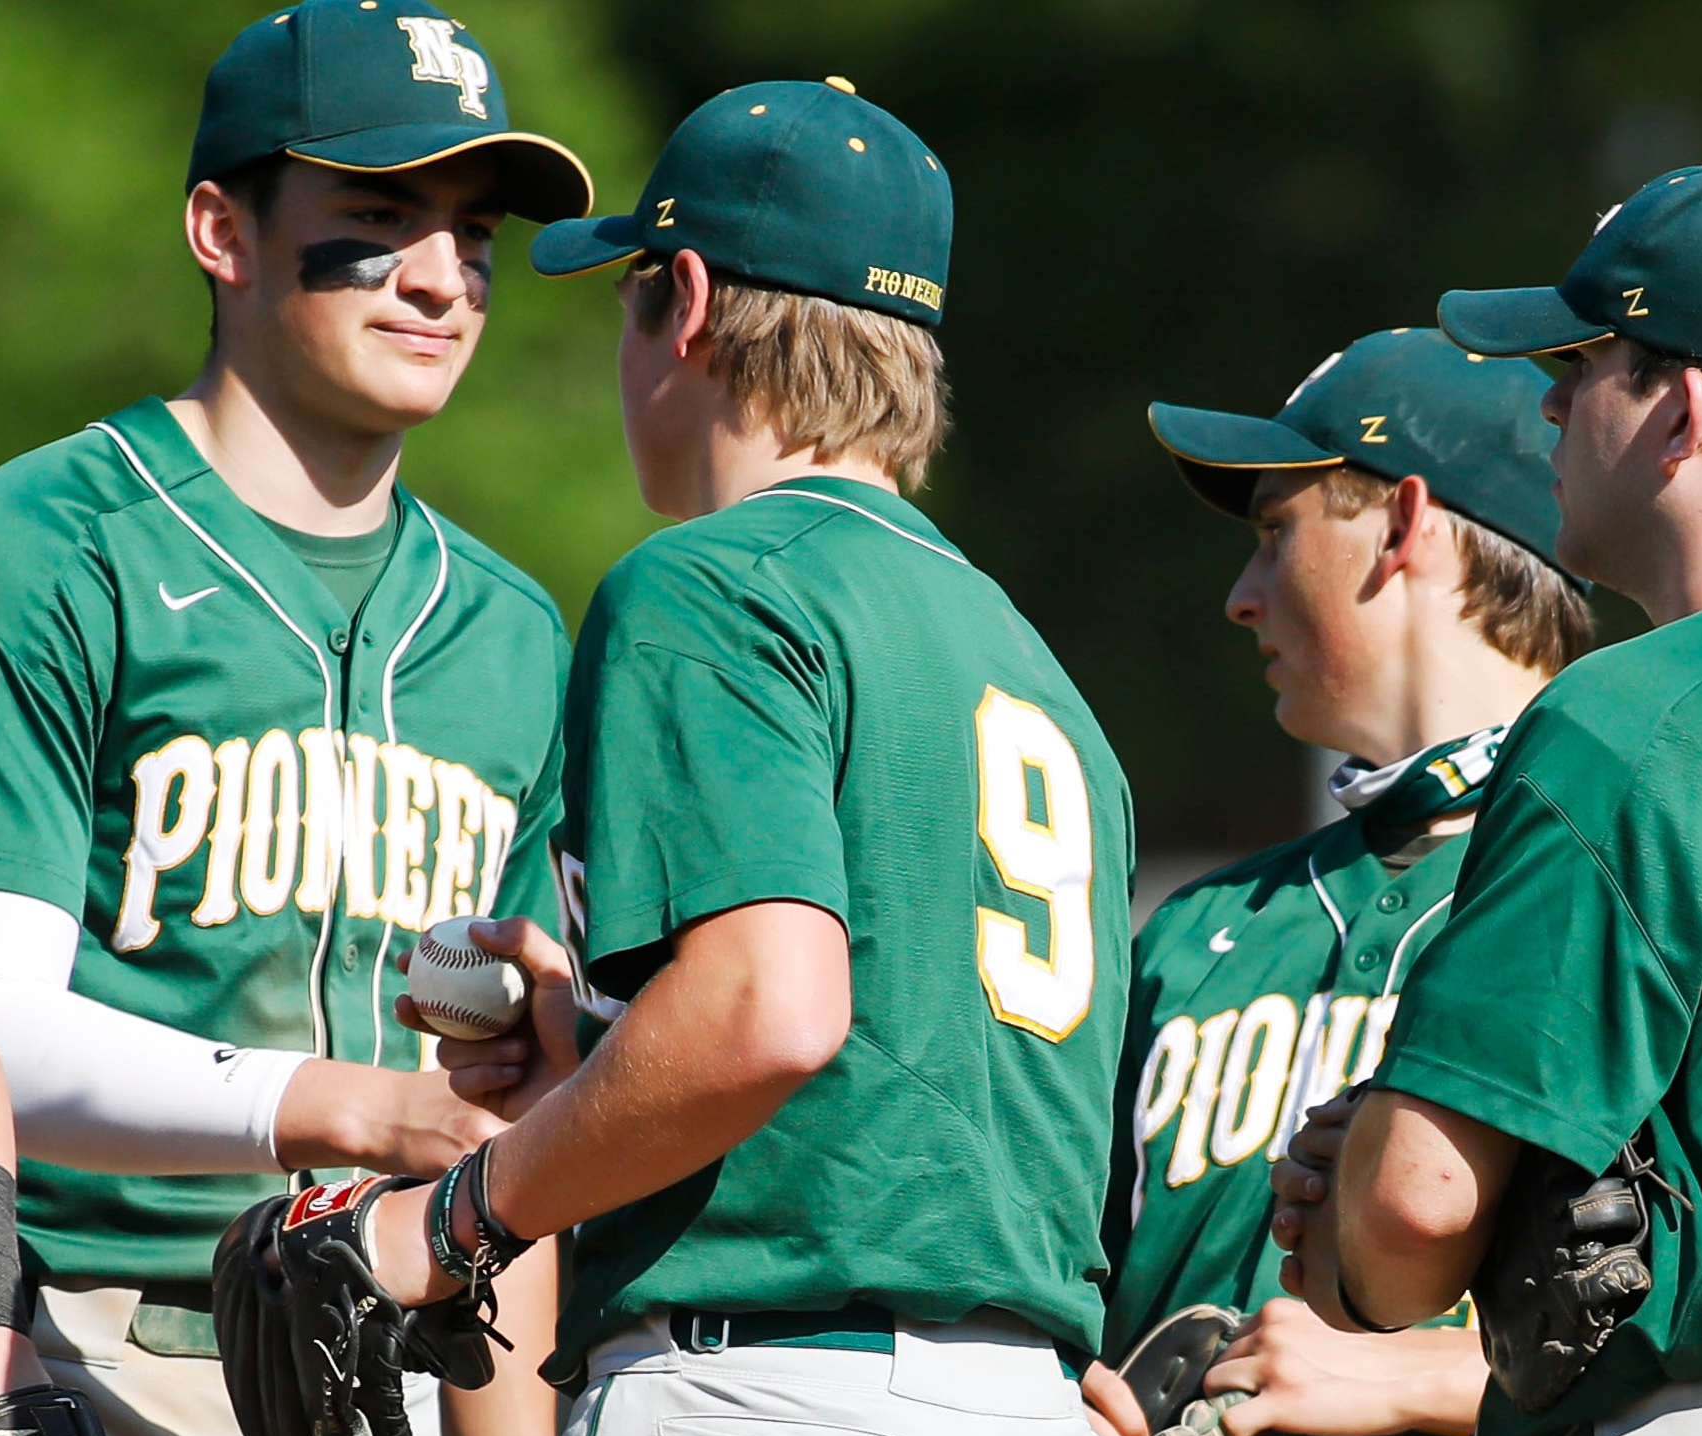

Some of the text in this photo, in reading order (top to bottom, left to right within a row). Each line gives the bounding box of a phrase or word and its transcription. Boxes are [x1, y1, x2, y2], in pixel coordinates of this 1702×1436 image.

[396, 17, 489, 120] NP
[656, 197, 676, 228] Z
[1621, 287, 1649, 317] Z
[1360, 415, 1388, 443] Z
[974, 683, 1095, 1043] 9
